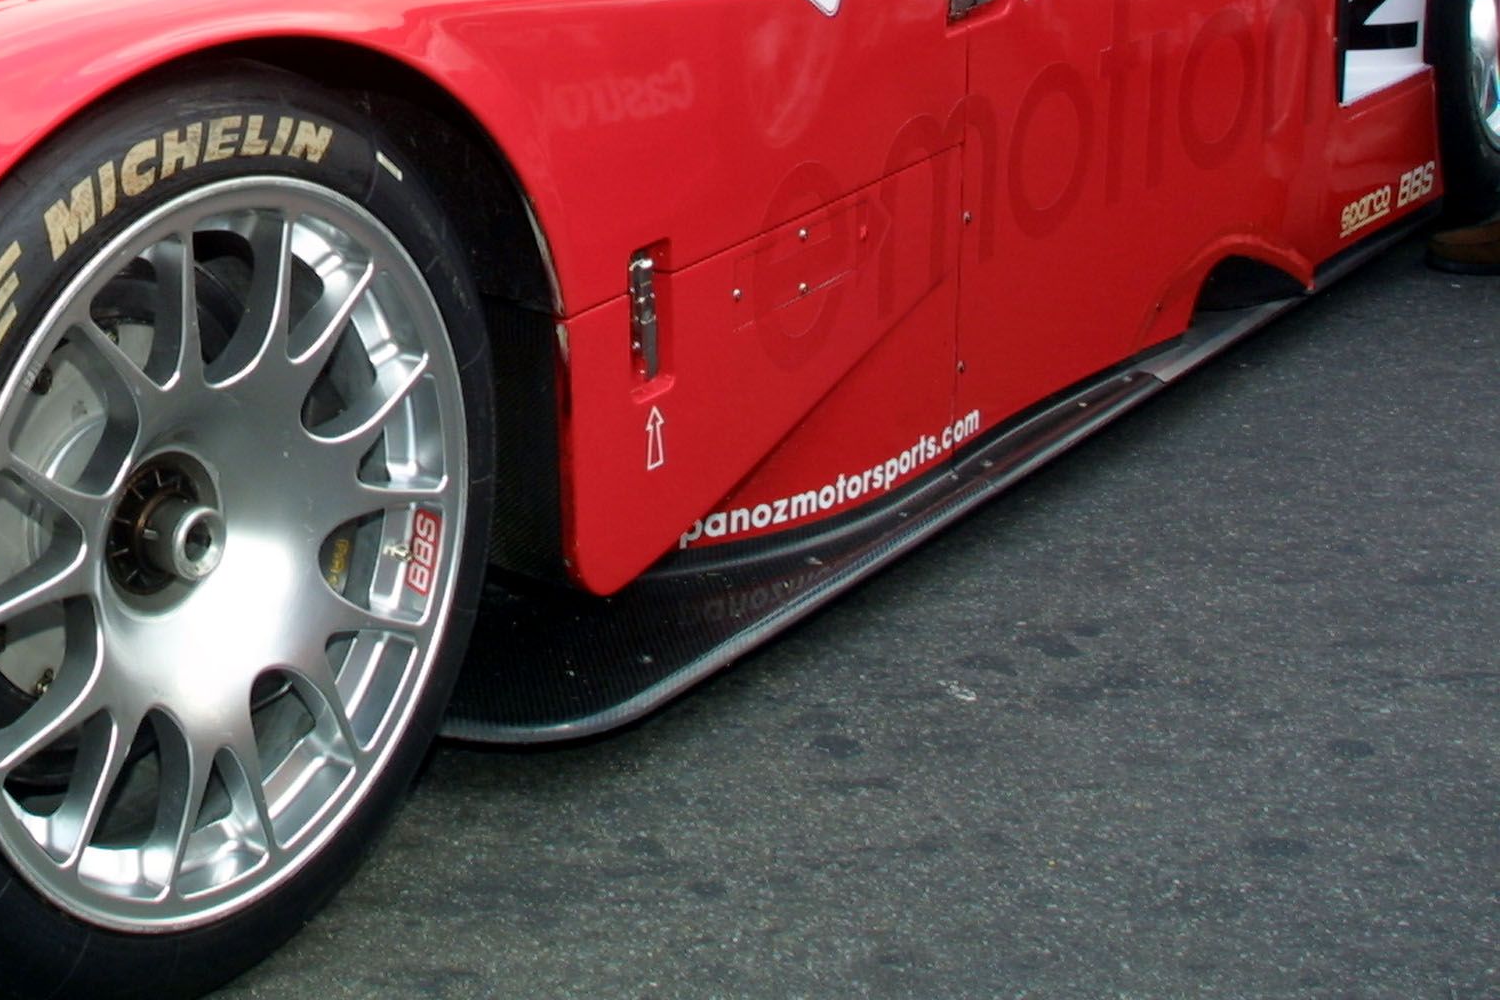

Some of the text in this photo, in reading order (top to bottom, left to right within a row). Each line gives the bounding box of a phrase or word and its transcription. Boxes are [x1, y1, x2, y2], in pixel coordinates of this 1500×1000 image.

[43, 114, 332, 261] MICHELIN
[1340, 160, 1435, 237] sparco BBS
[679, 409, 980, 550] panozmotorsports.com
[408, 512, 437, 594] BBS
